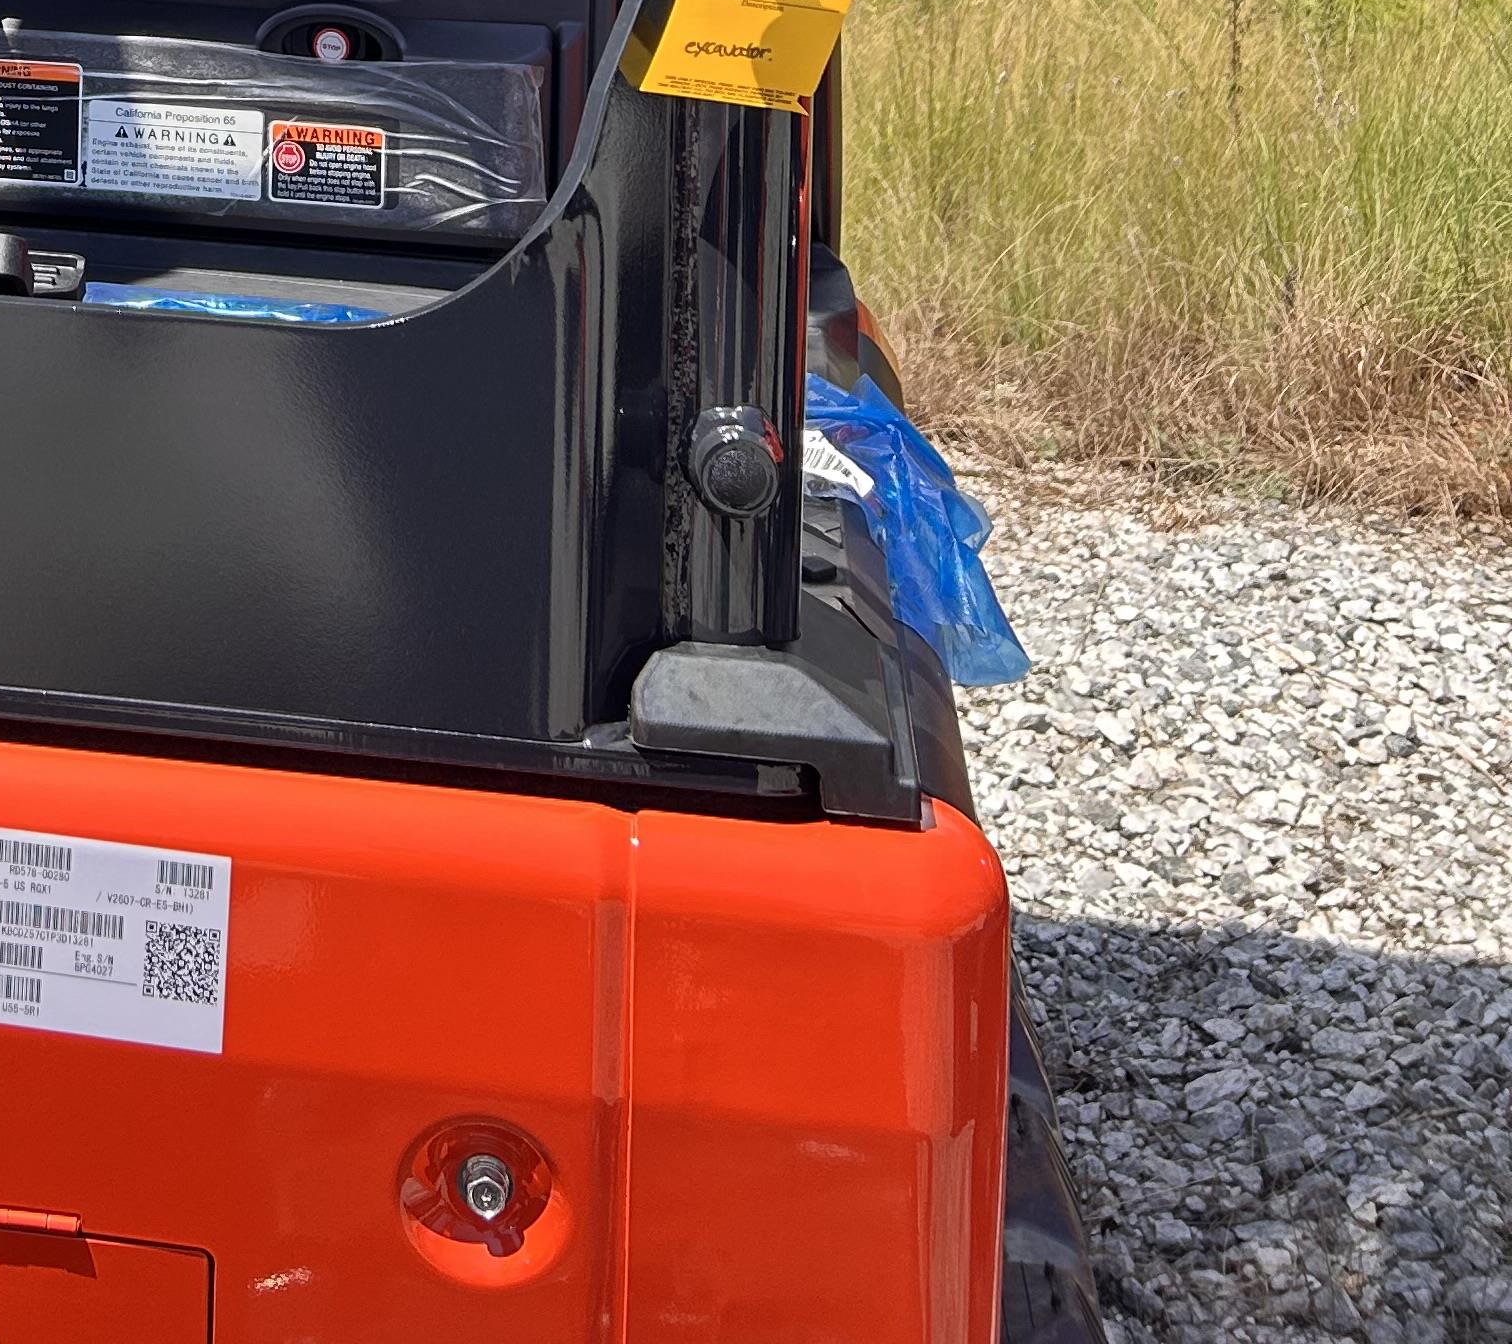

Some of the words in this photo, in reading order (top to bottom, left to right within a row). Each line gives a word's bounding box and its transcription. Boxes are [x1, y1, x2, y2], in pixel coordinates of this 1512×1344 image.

[115, 107, 162, 120] California
[165, 110, 221, 125] Proposition
[223, 116, 236, 125] 65
[134, 126, 219, 145] WARNING
[296, 127, 375, 145] WARNING
[92, 138, 118, 147] Engine
[120, 150, 146, 158] vehicle
[123, 170, 160, 179] California
[14, 882, 25, 891] US
[97, 954, 114, 965] S/N
